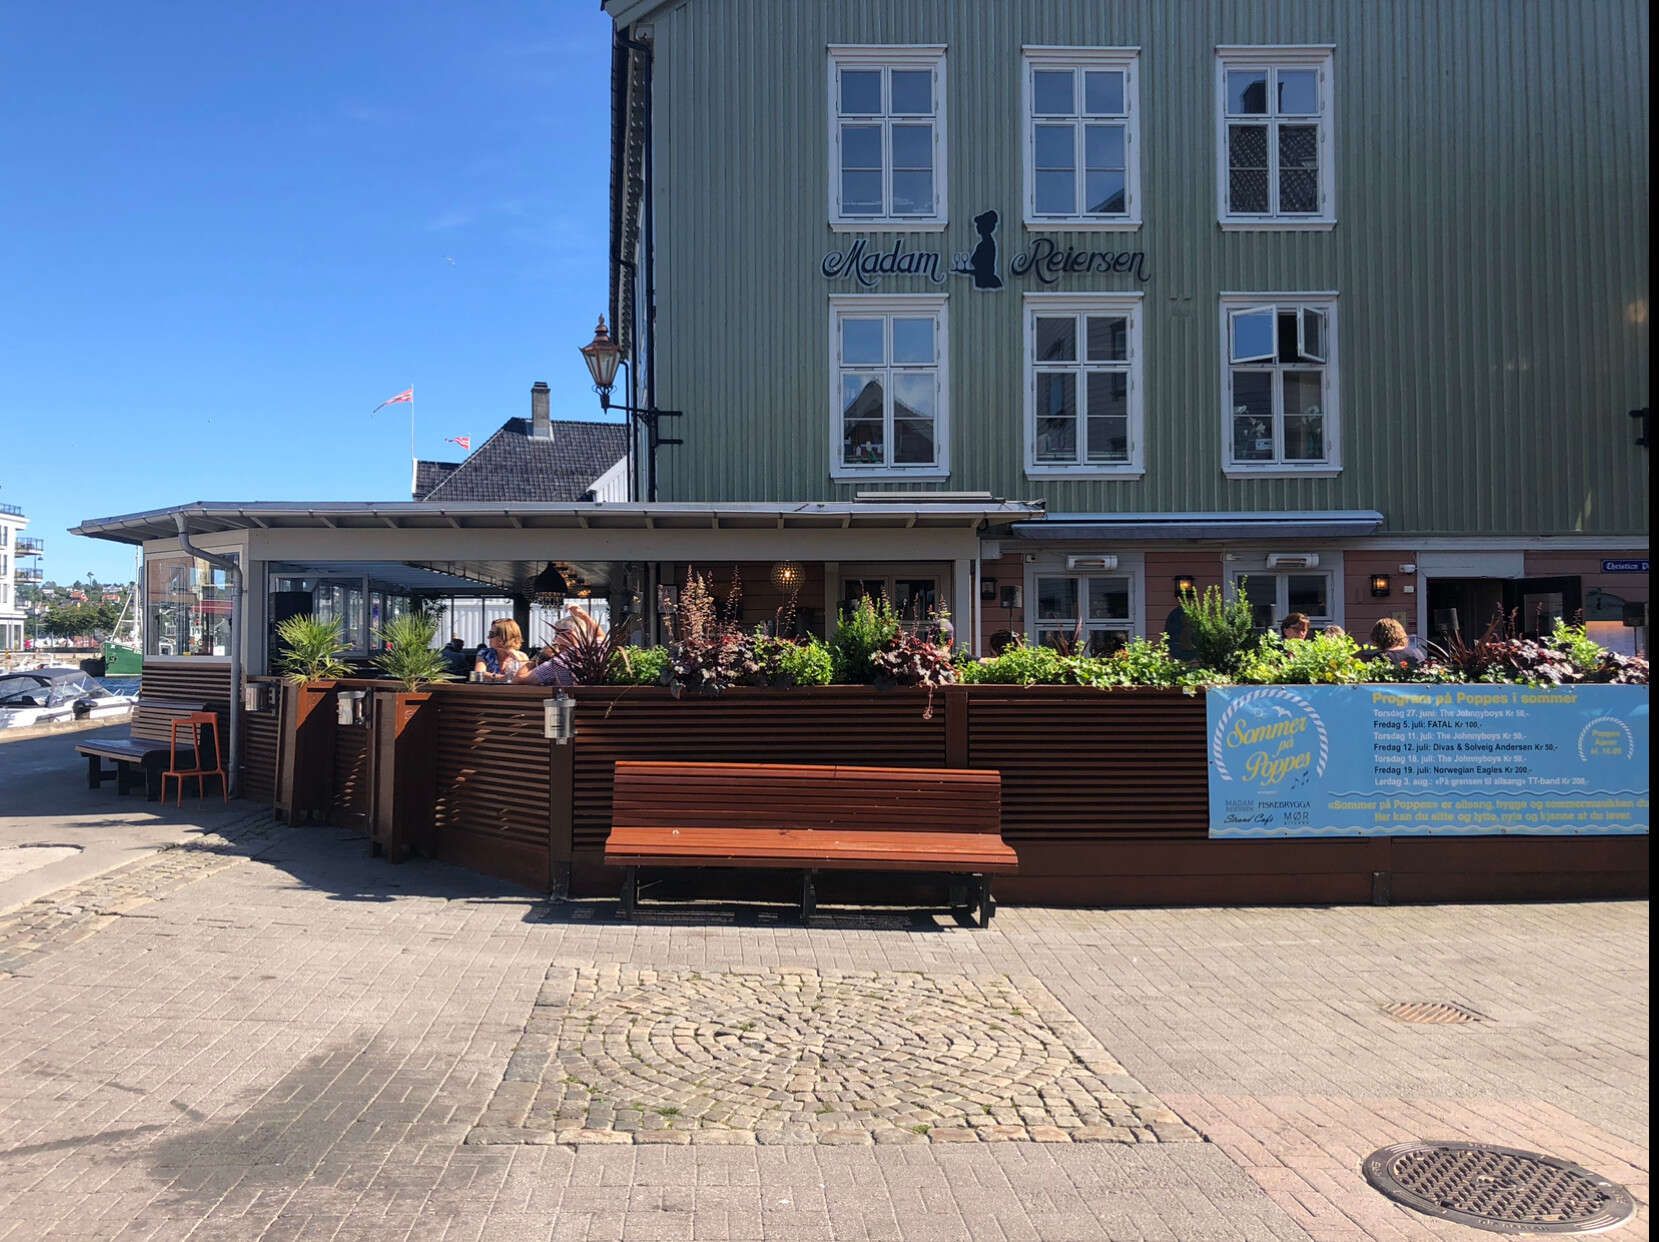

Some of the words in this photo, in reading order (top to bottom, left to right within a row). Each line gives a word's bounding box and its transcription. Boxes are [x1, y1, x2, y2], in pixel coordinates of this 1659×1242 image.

[822, 238, 946, 287] Madam
[1011, 237, 1151, 284] Reiersen
[1372, 692, 1431, 707] Program
[1436, 692, 1452, 707] på
[1457, 692, 1508, 707] Poppes
[1521, 694, 1577, 704] sommer
[1374, 709, 1405, 718] Torsdag
[1406, 709, 1418, 717] 27.
[1440, 709, 1454, 717] The
[1456, 709, 1504, 718] Johnnyboys
[1505, 709, 1515, 717] Kr
[1373, 721, 1401, 730] Fredag
[1403, 721, 1411, 729] 5.
[1411, 721, 1426, 730] juli:
[1428, 721, 1453, 729] FATAL
[1454, 721, 1464, 729] Kr
[1226, 717, 1309, 748] Sommer
[1374, 732, 1405, 741] Torsdag
[1407, 732, 1418, 740] 11.
[1437, 732, 1451, 740] The
[1454, 732, 1501, 741] Johnnyboys
[1502, 732, 1511, 740] Kr
[1273, 737, 1295, 756] på
[1373, 744, 1401, 753] Fredag
[1403, 744, 1415, 752] 12.
[1416, 744, 1431, 753] juli:
[1433, 744, 1454, 752] Divas
[1457, 744, 1462, 752] &
[1464, 744, 1493, 753] Solveig
[1495, 744, 1533, 752] Andersen
[1534, 744, 1543, 752] Kr
[1375, 755, 1406, 764] Torsdag
[1438, 755, 1452, 763] The
[1454, 755, 1501, 764] Johnnyboys
[1503, 755, 1512, 763] Kr
[1241, 752, 1312, 785] Poppes
[1374, 766, 1401, 775] Fredag
[1404, 766, 1415, 774] 19.
[1416, 766, 1431, 775] juli:
[1433, 766, 1475, 775] Norwegian
[1477, 766, 1502, 775] Eagles
[1504, 766, 1513, 774] Kr
[1375, 777, 1402, 787] Lørdag
[1527, 777, 1560, 786] TT-band
[1561, 777, 1570, 786] Kr
[1284, 812, 1309, 820] MØR
